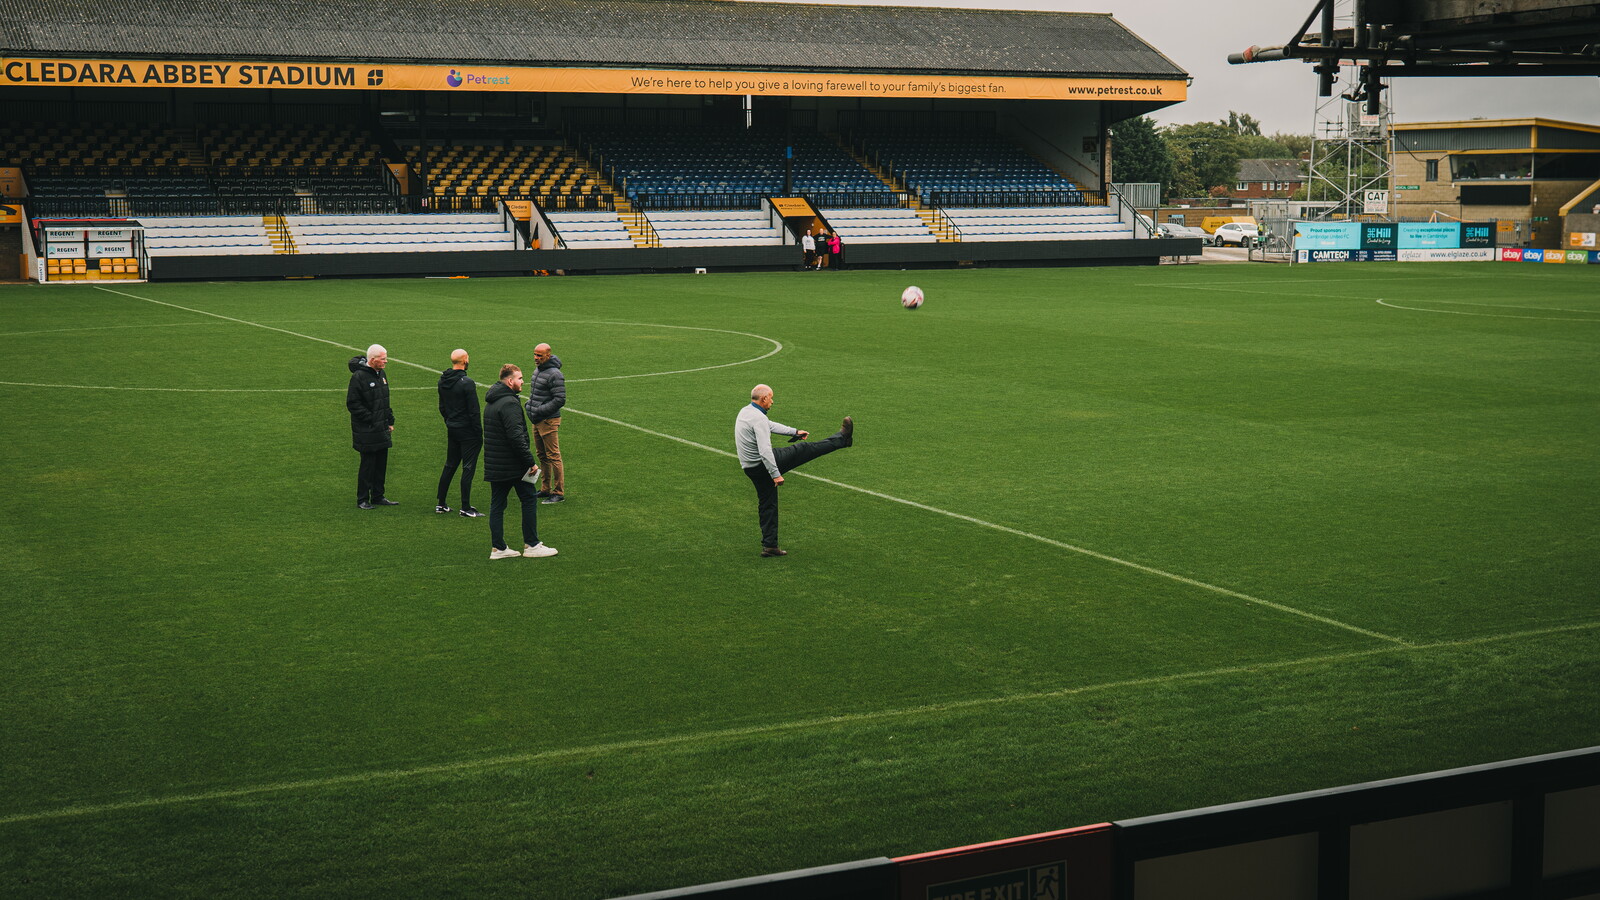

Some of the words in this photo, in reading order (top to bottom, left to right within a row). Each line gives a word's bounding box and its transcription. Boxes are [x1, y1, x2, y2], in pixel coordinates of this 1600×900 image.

[5, 61, 136, 83] CLEDARA
[142, 64, 232, 84] ABBEY
[238, 65, 355, 86] STADIUM
[467, 74, 510, 84] Petrest
[666, 78, 692, 88] here
[694, 79, 706, 88] to
[708, 78, 732, 90] help
[735, 81, 755, 91] you
[758, 80, 780, 91] give
[782, 82, 789, 90] a
[792, 80, 823, 92] loving
[826, 80, 867, 90] farewell
[870, 82, 880, 91] to
[882, 83, 905, 94] your
[908, 82, 946, 94] family's
[948, 82, 986, 94] biggest
[988, 82, 1006, 92] fan.
[1068, 86, 1162, 96] www.petrest.co.uk
[1367, 192, 1385, 200] CAT
[1376, 228, 1391, 238] Hill
[1474, 227, 1489, 237] Hill
[1402, 251, 1421, 259] elglaze
[1504, 250, 1521, 260] ebay
[1524, 250, 1542, 261] ebay
[1546, 251, 1564, 261] ebay
[1567, 252, 1586, 262] ebay
[980, 882, 1025, 900] EXIT
